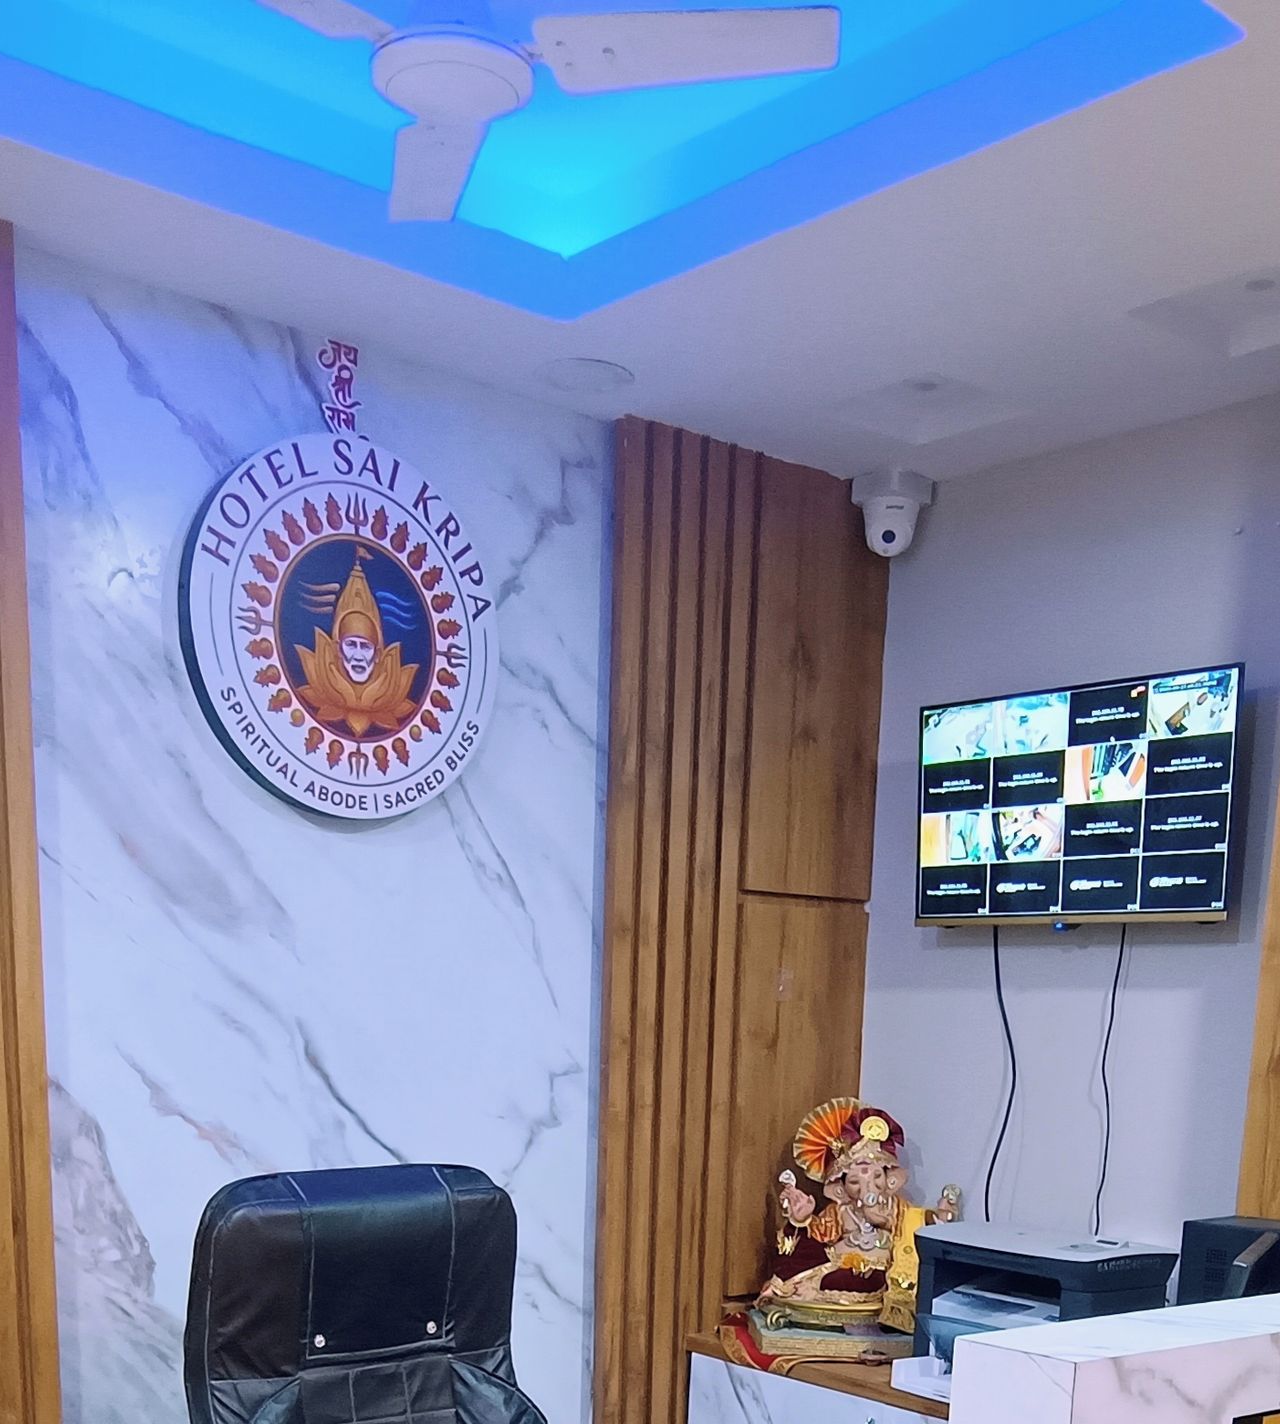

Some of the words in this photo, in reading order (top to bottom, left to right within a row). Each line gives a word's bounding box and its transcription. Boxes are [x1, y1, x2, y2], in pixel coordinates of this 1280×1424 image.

[317, 338, 358, 369] जय
[201, 441, 320, 567] HOTEL
[332, 437, 401, 492] SAI
[412, 481, 492, 624] KRIPA
[220, 686, 300, 788] SPIRITUAL
[303, 780, 369, 812] ABODE
[383, 768, 446, 810] SACRED
[444, 721, 481, 774] BLISS
